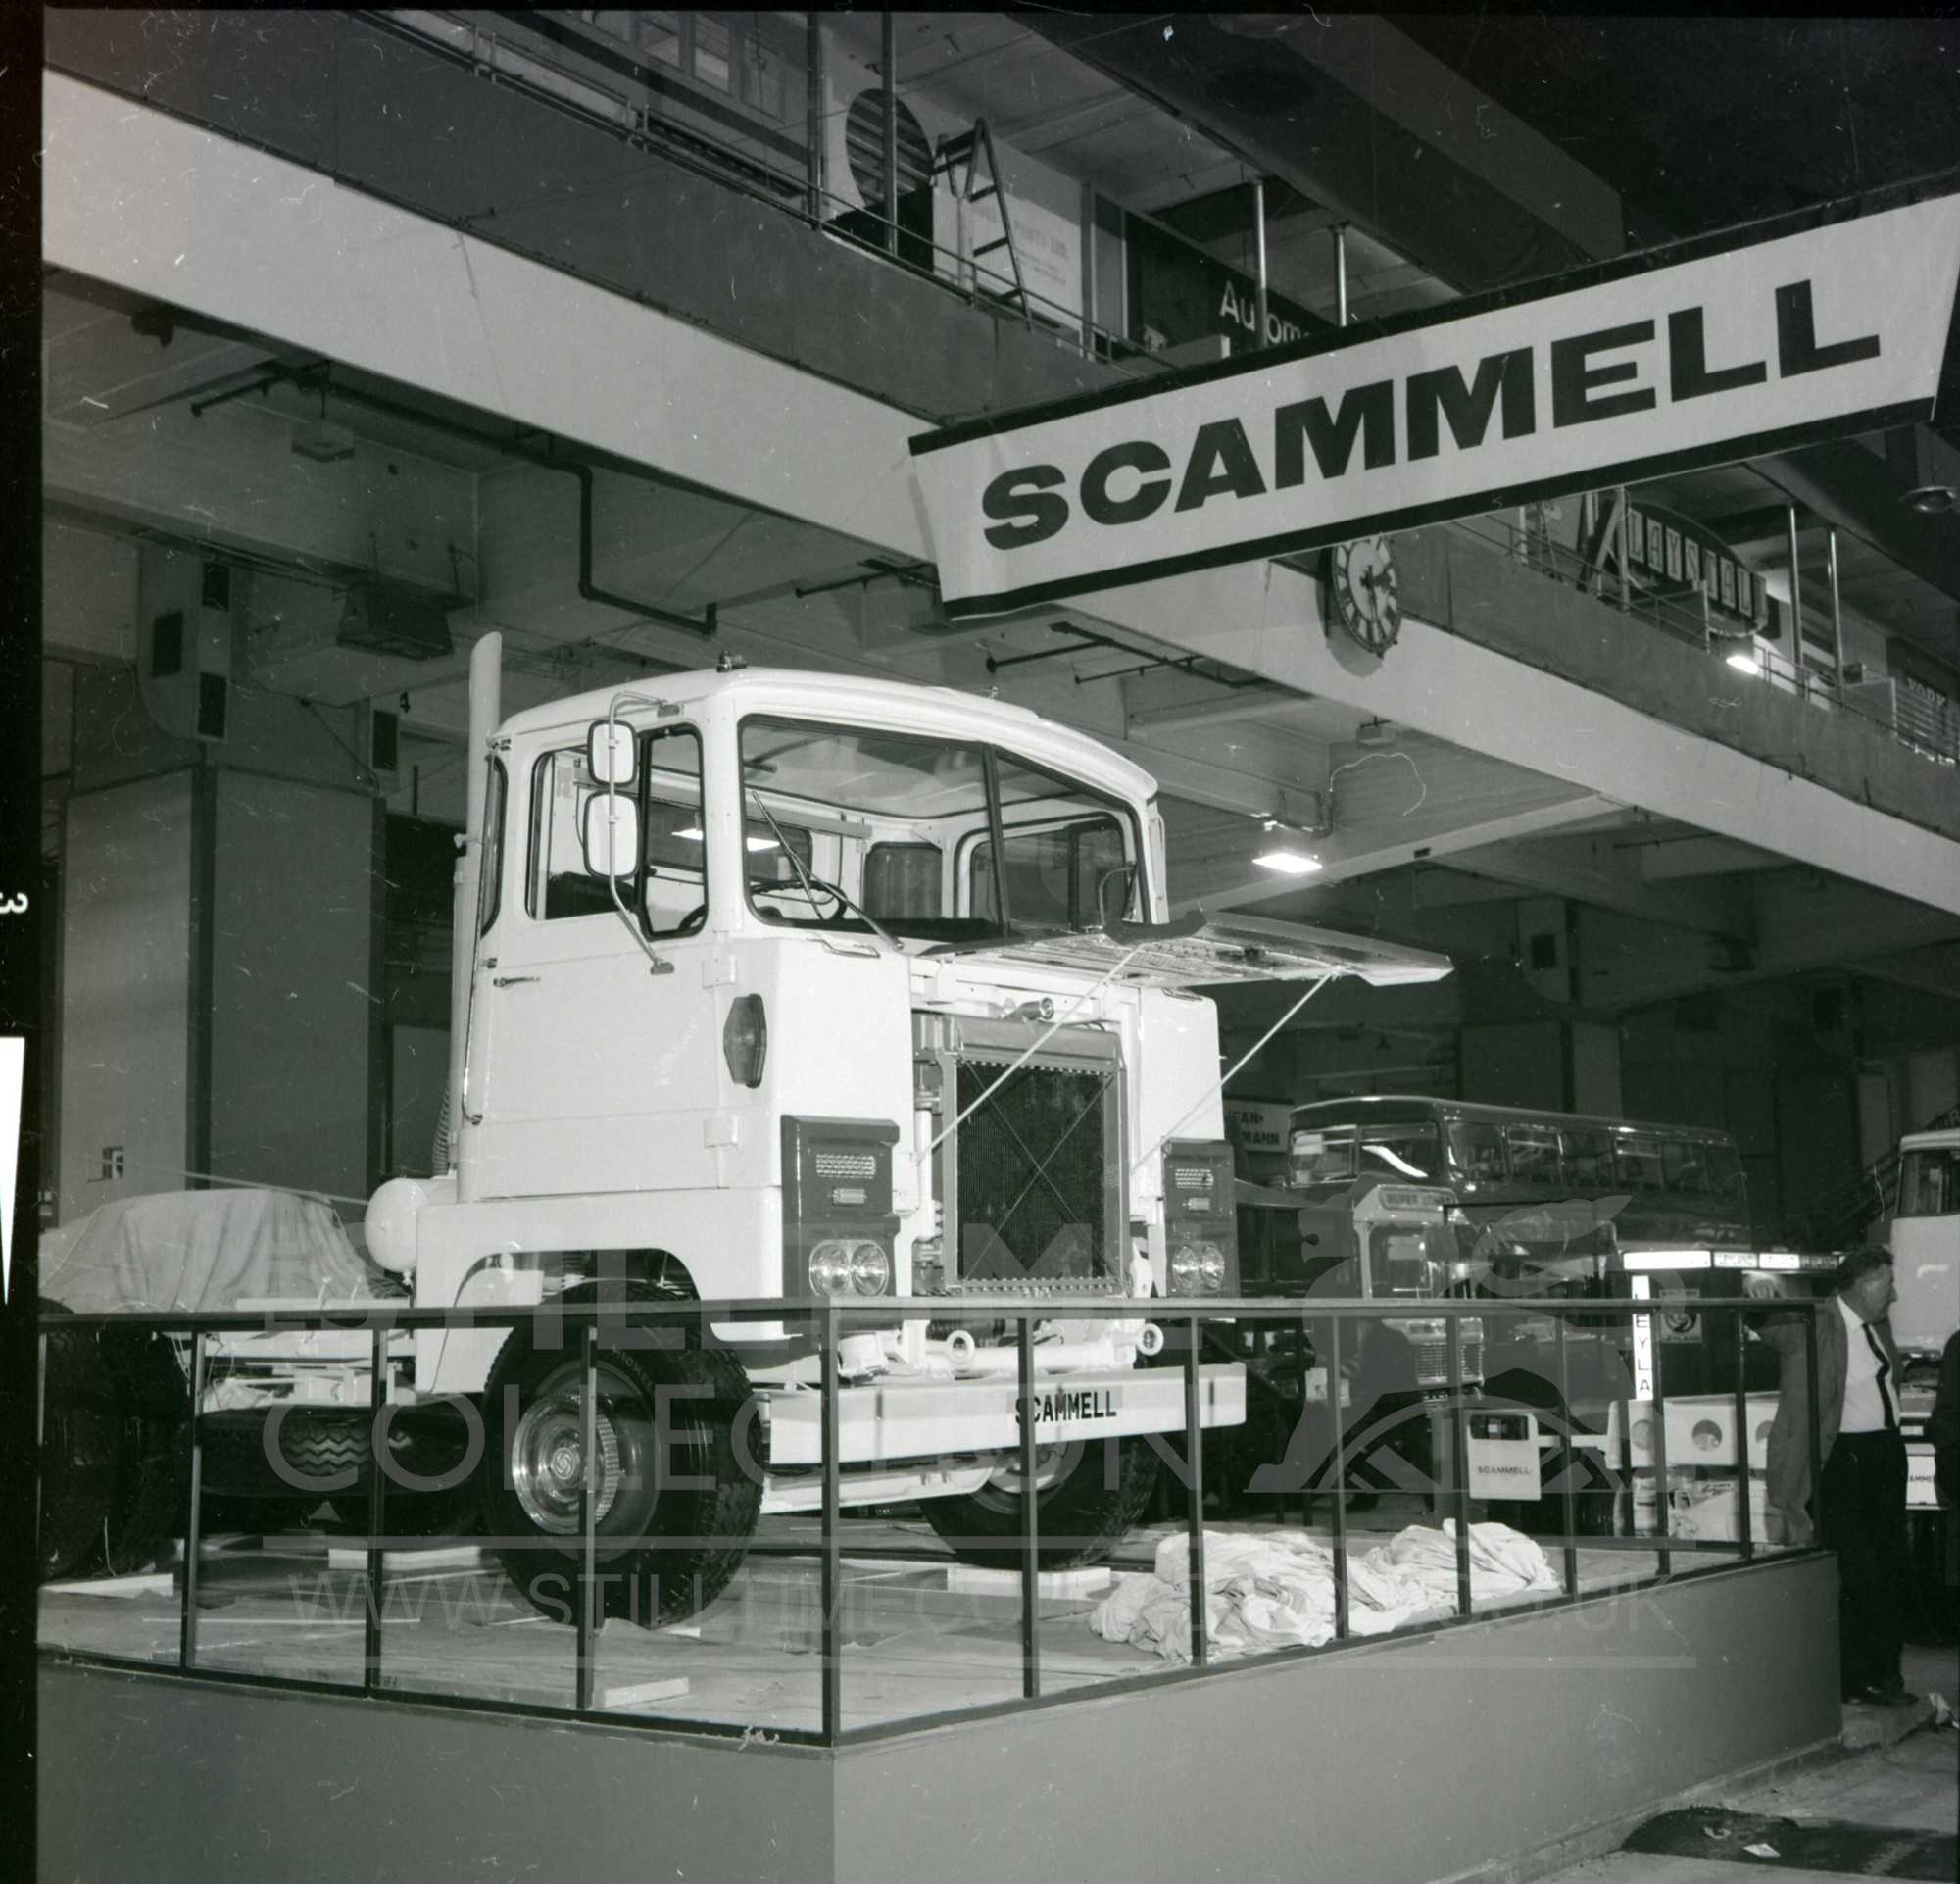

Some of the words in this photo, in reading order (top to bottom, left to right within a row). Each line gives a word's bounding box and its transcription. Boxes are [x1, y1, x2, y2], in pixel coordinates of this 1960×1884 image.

[1220, 280, 1310, 344] Auom
[982, 279, 1881, 551] SCAMMELL
[1477, 1465, 1532, 1475] SCAMMELL
